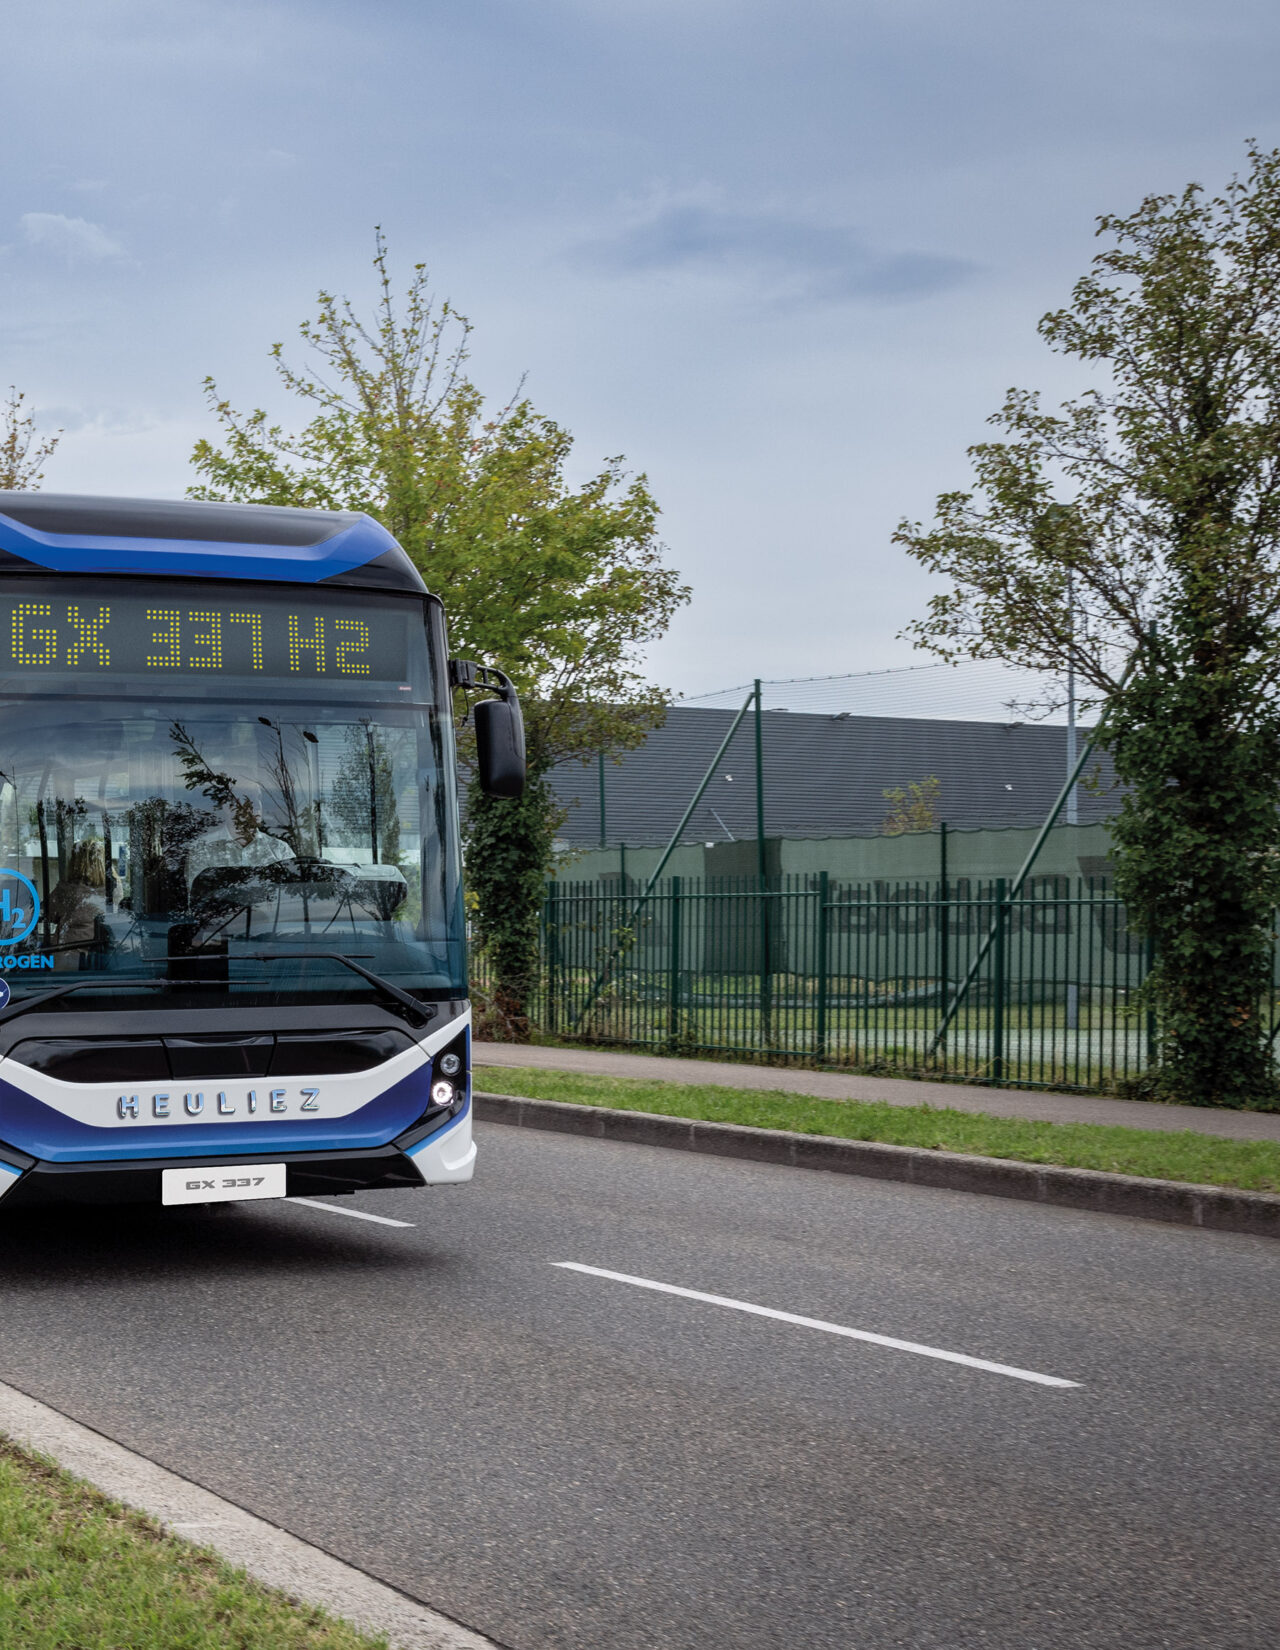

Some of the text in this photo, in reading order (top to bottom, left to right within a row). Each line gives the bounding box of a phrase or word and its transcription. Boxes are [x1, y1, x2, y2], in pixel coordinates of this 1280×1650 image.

[11, 603, 371, 675] GX 337 H2
[118, 1088, 320, 1118] HEULIEZ
[185, 1177, 265, 1191] GX 337
